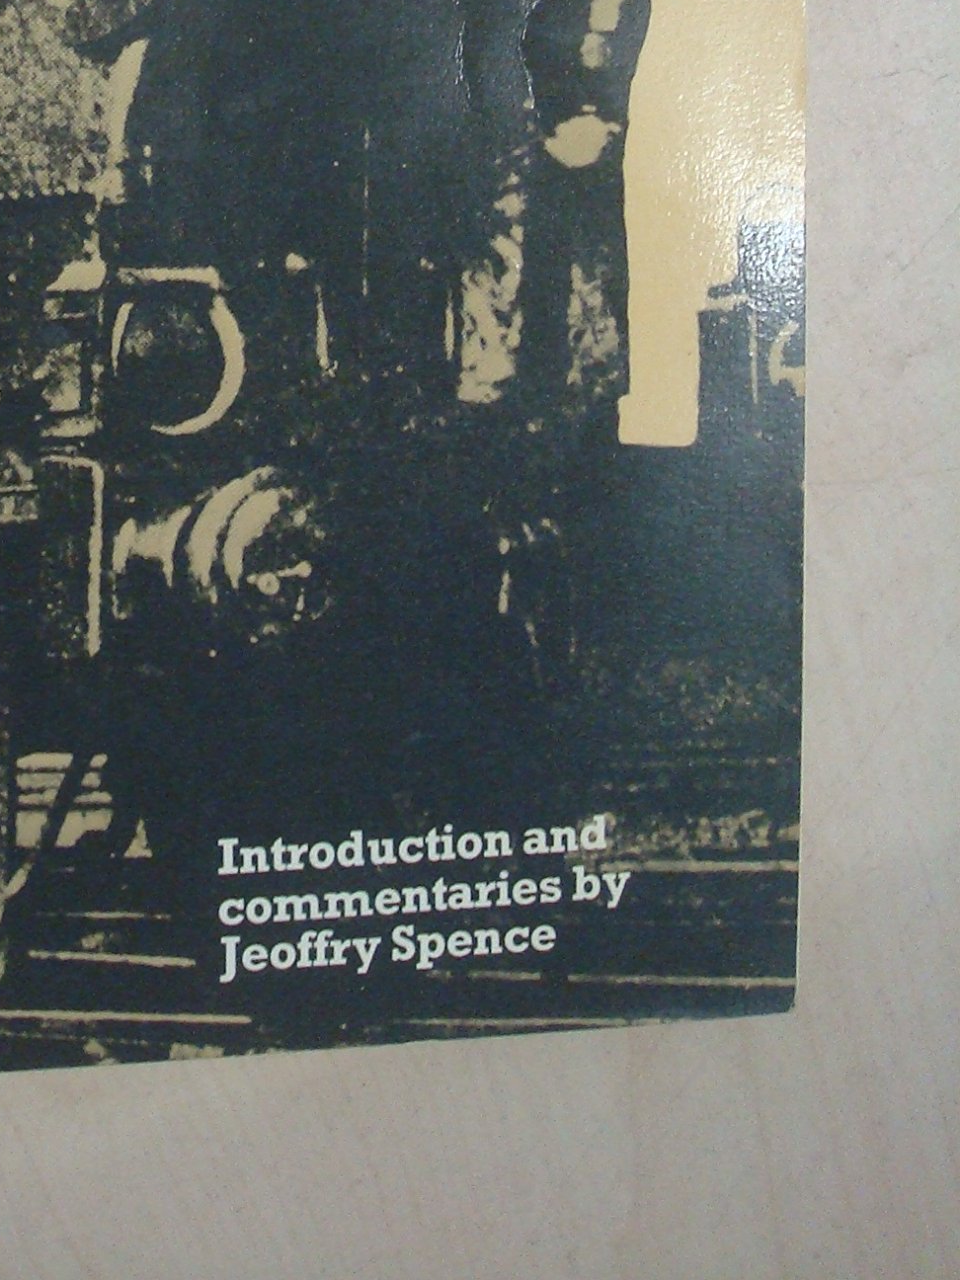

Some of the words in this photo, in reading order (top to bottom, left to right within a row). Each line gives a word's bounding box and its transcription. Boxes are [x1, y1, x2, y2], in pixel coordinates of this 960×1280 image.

[217, 823, 513, 875] Introduction
[523, 814, 609, 856] and
[217, 870, 562, 926] commentaries
[571, 865, 632, 909] by
[219, 930, 382, 984] Jeoffry
[390, 923, 557, 970] Spence
